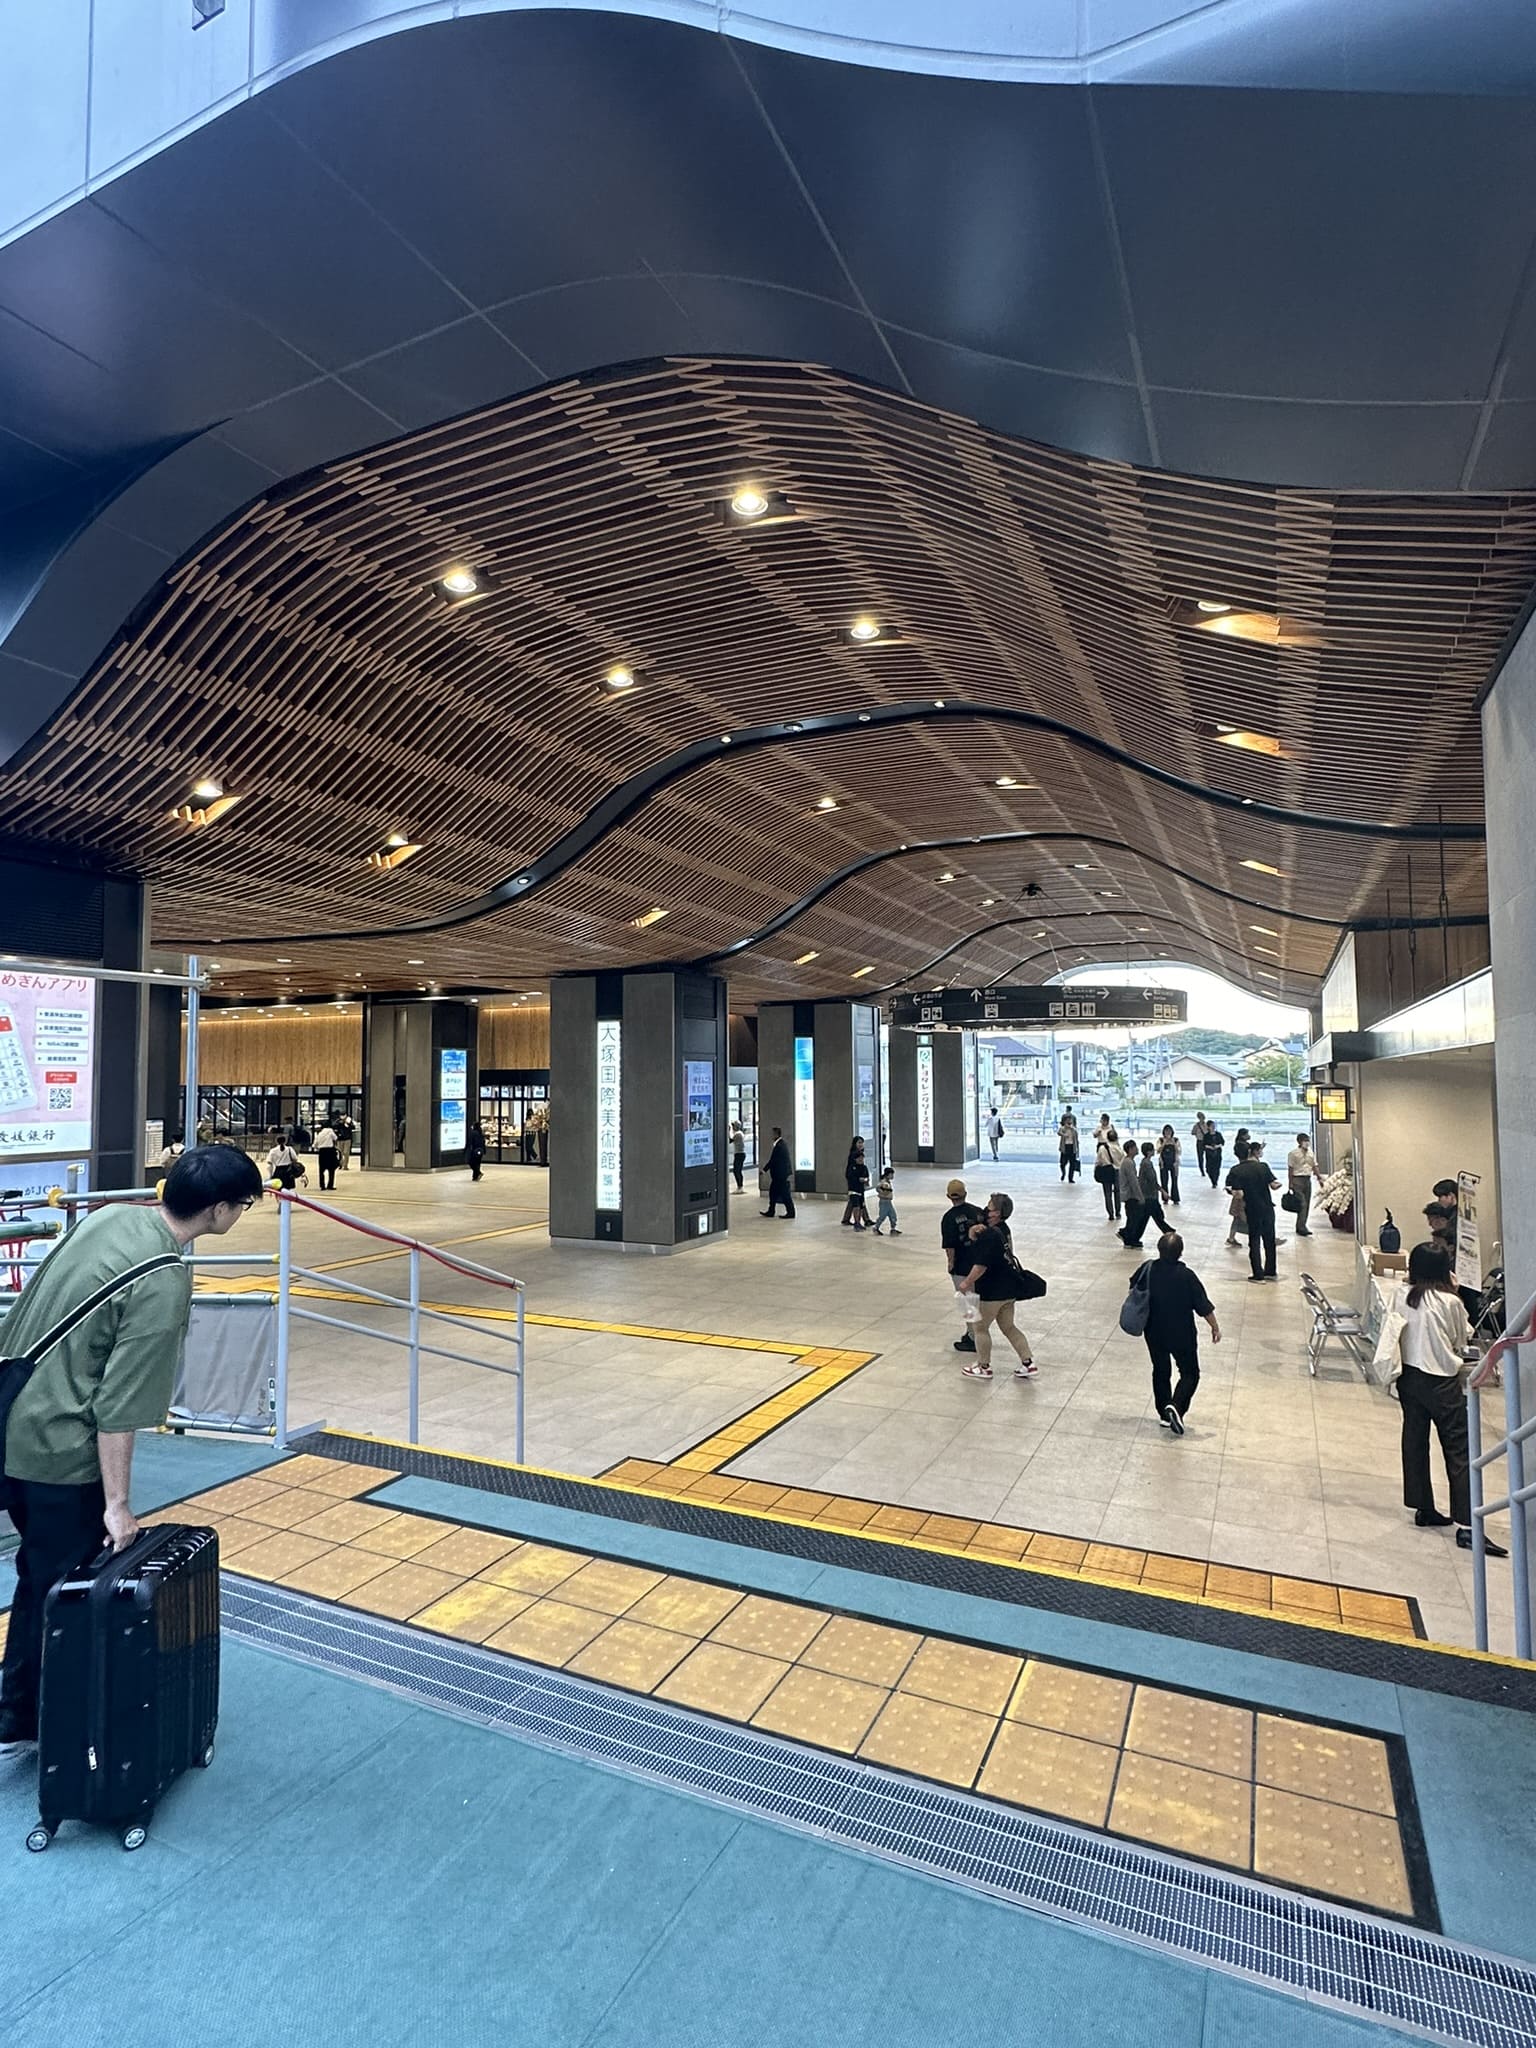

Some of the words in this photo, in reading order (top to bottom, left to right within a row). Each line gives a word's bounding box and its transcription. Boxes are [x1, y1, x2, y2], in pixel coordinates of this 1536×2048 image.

[600, 1024, 616, 1169] 大塚国際美術館
